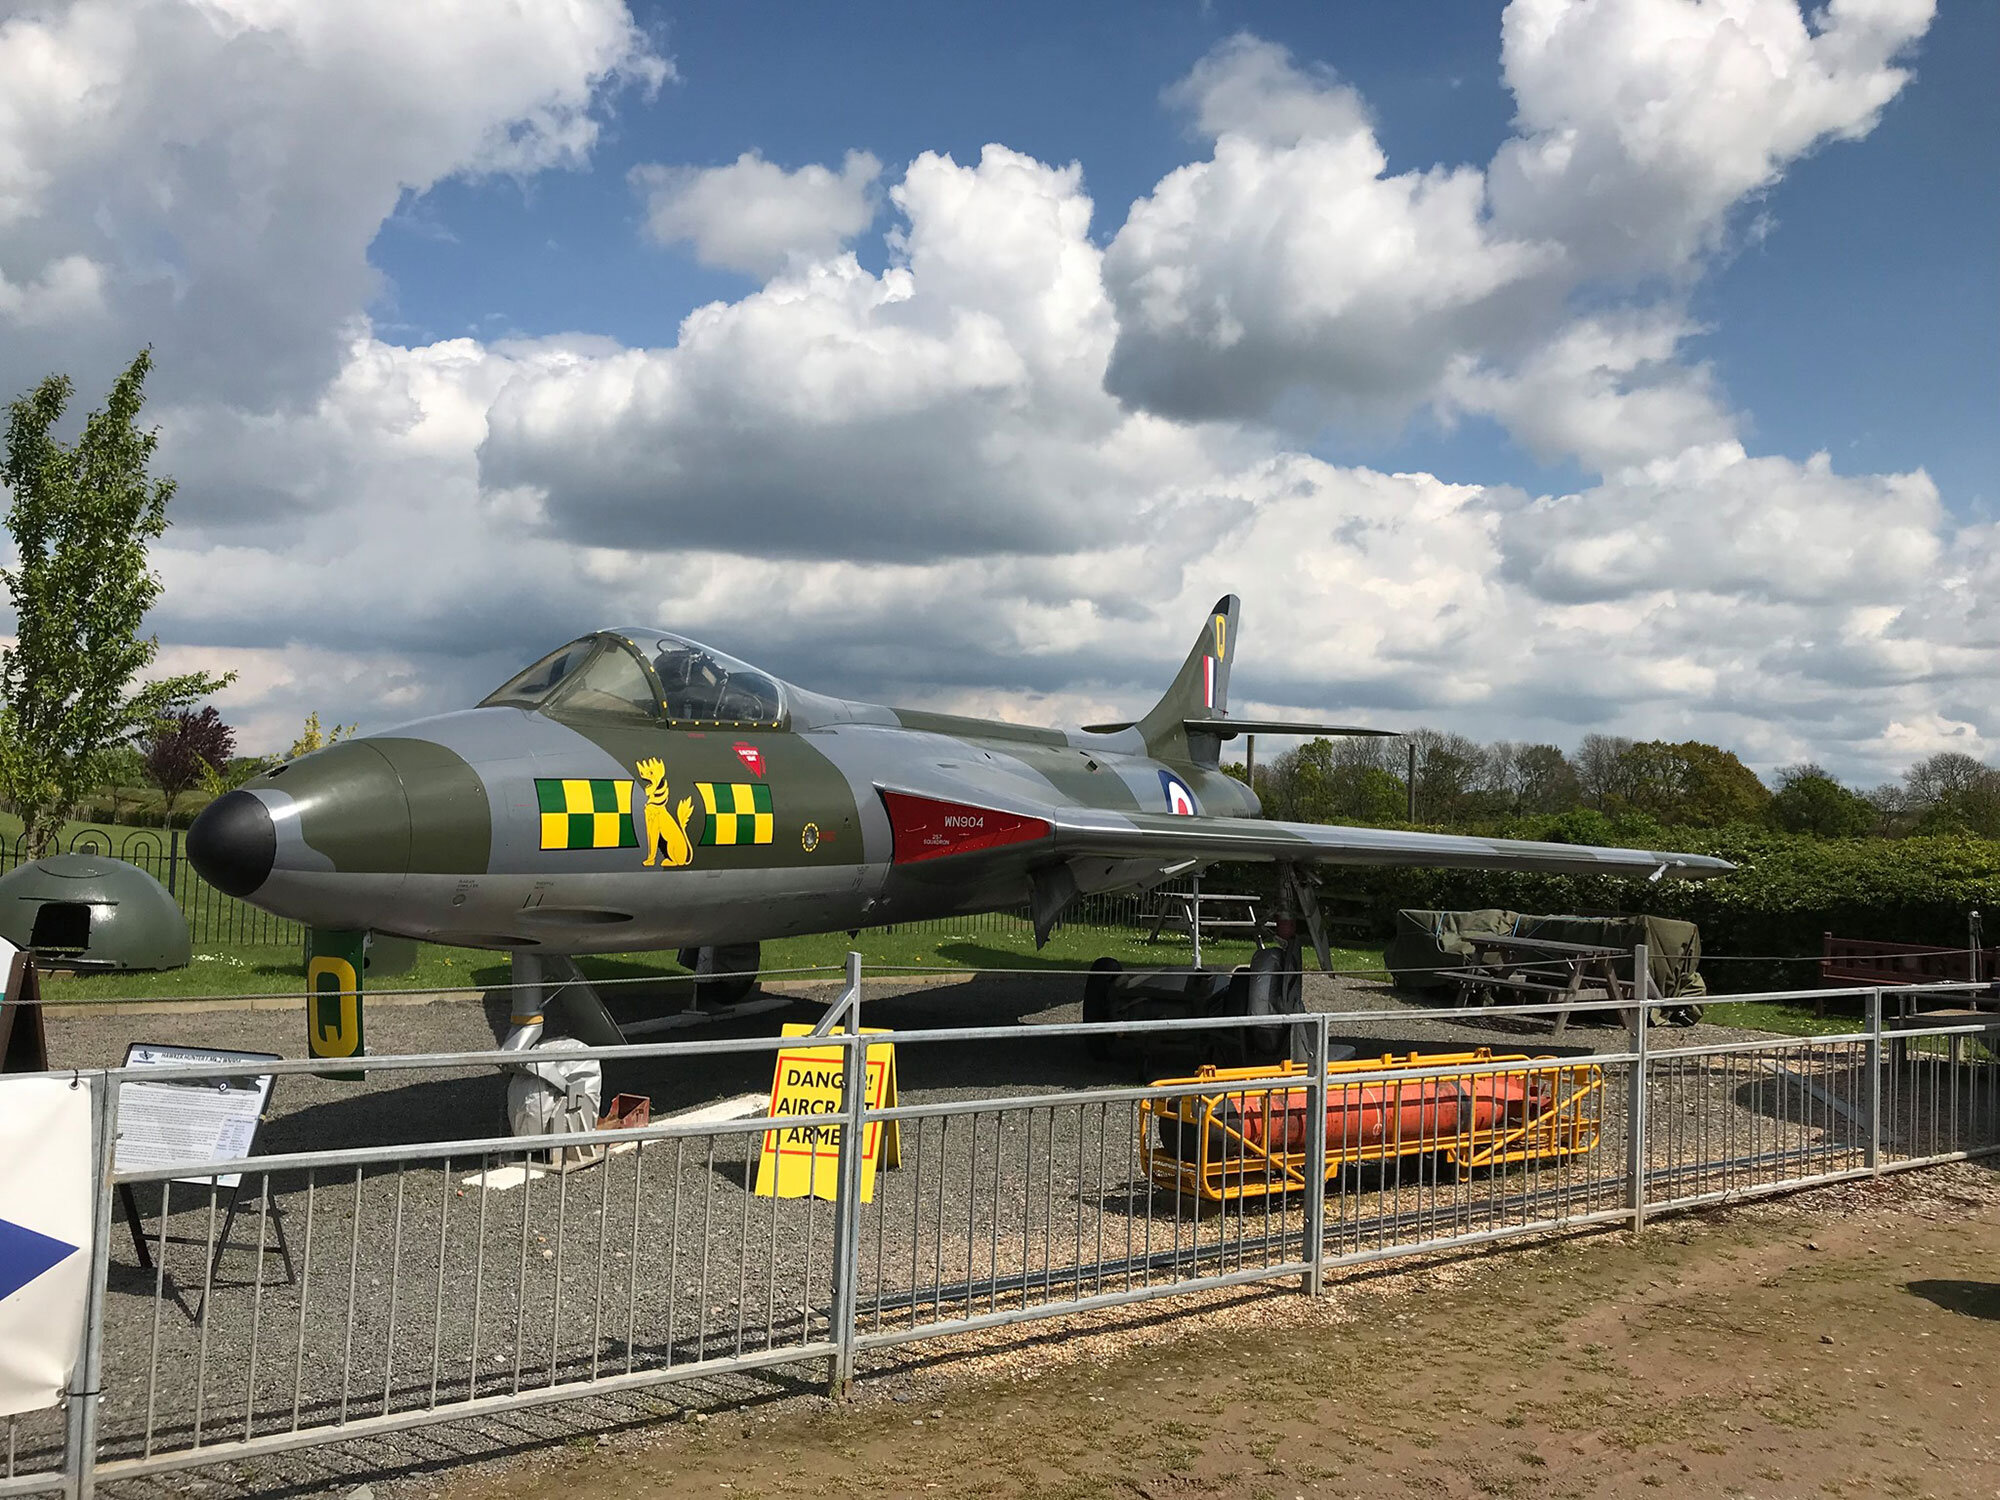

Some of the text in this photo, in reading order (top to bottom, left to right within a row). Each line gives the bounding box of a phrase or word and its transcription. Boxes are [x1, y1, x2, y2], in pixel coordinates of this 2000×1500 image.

[944, 815, 984, 828] WN904
[308, 955, 358, 1057] Q
[787, 1069, 873, 1091] DANG!
[777, 1097, 874, 1116] AIRCRT
[786, 1126, 841, 1146] ARME
